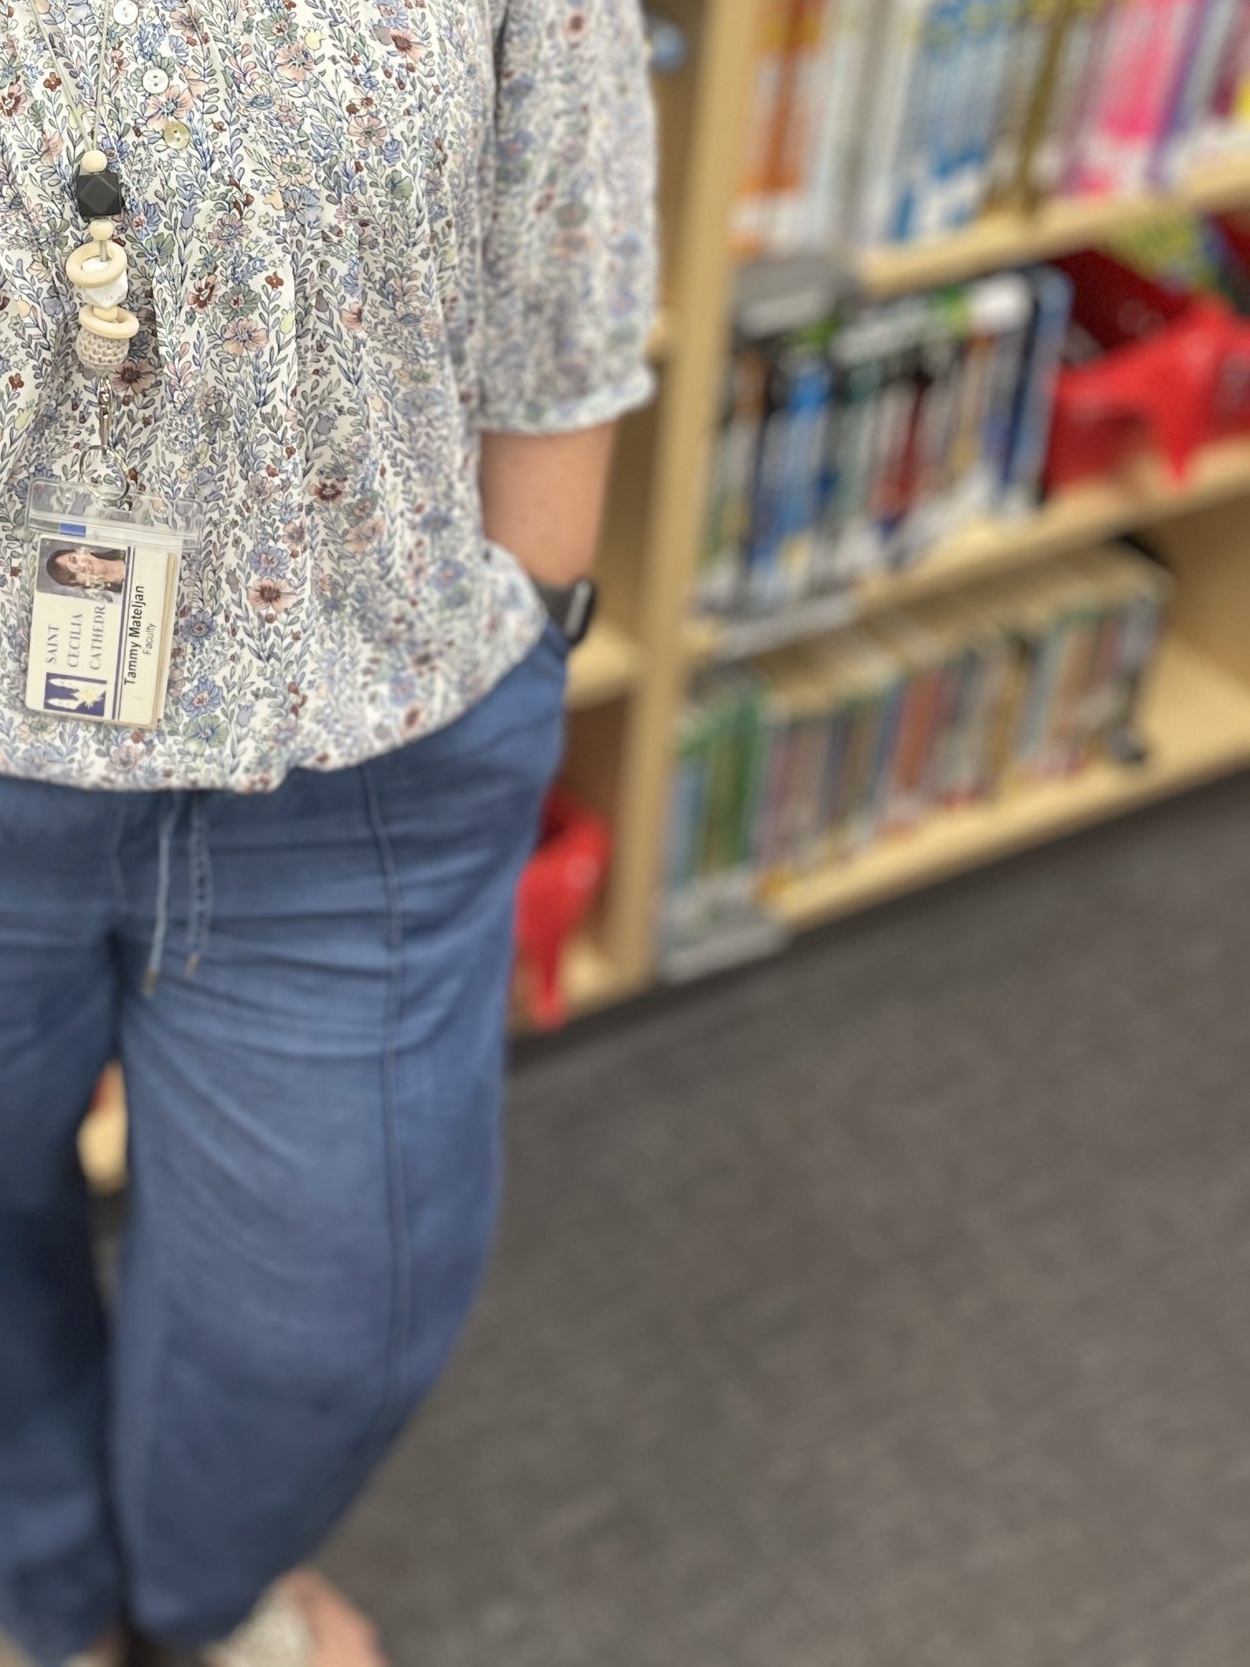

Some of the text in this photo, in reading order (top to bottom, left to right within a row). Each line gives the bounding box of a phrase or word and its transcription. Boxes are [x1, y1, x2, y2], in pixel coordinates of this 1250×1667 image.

[46, 624, 60, 665] SAINT
[67, 614, 83, 668] CECILIA
[89, 604, 106, 670] CATHEDR
[123, 585, 147, 685] Tammy Mateljan
[143, 623, 157, 655] Faculty
